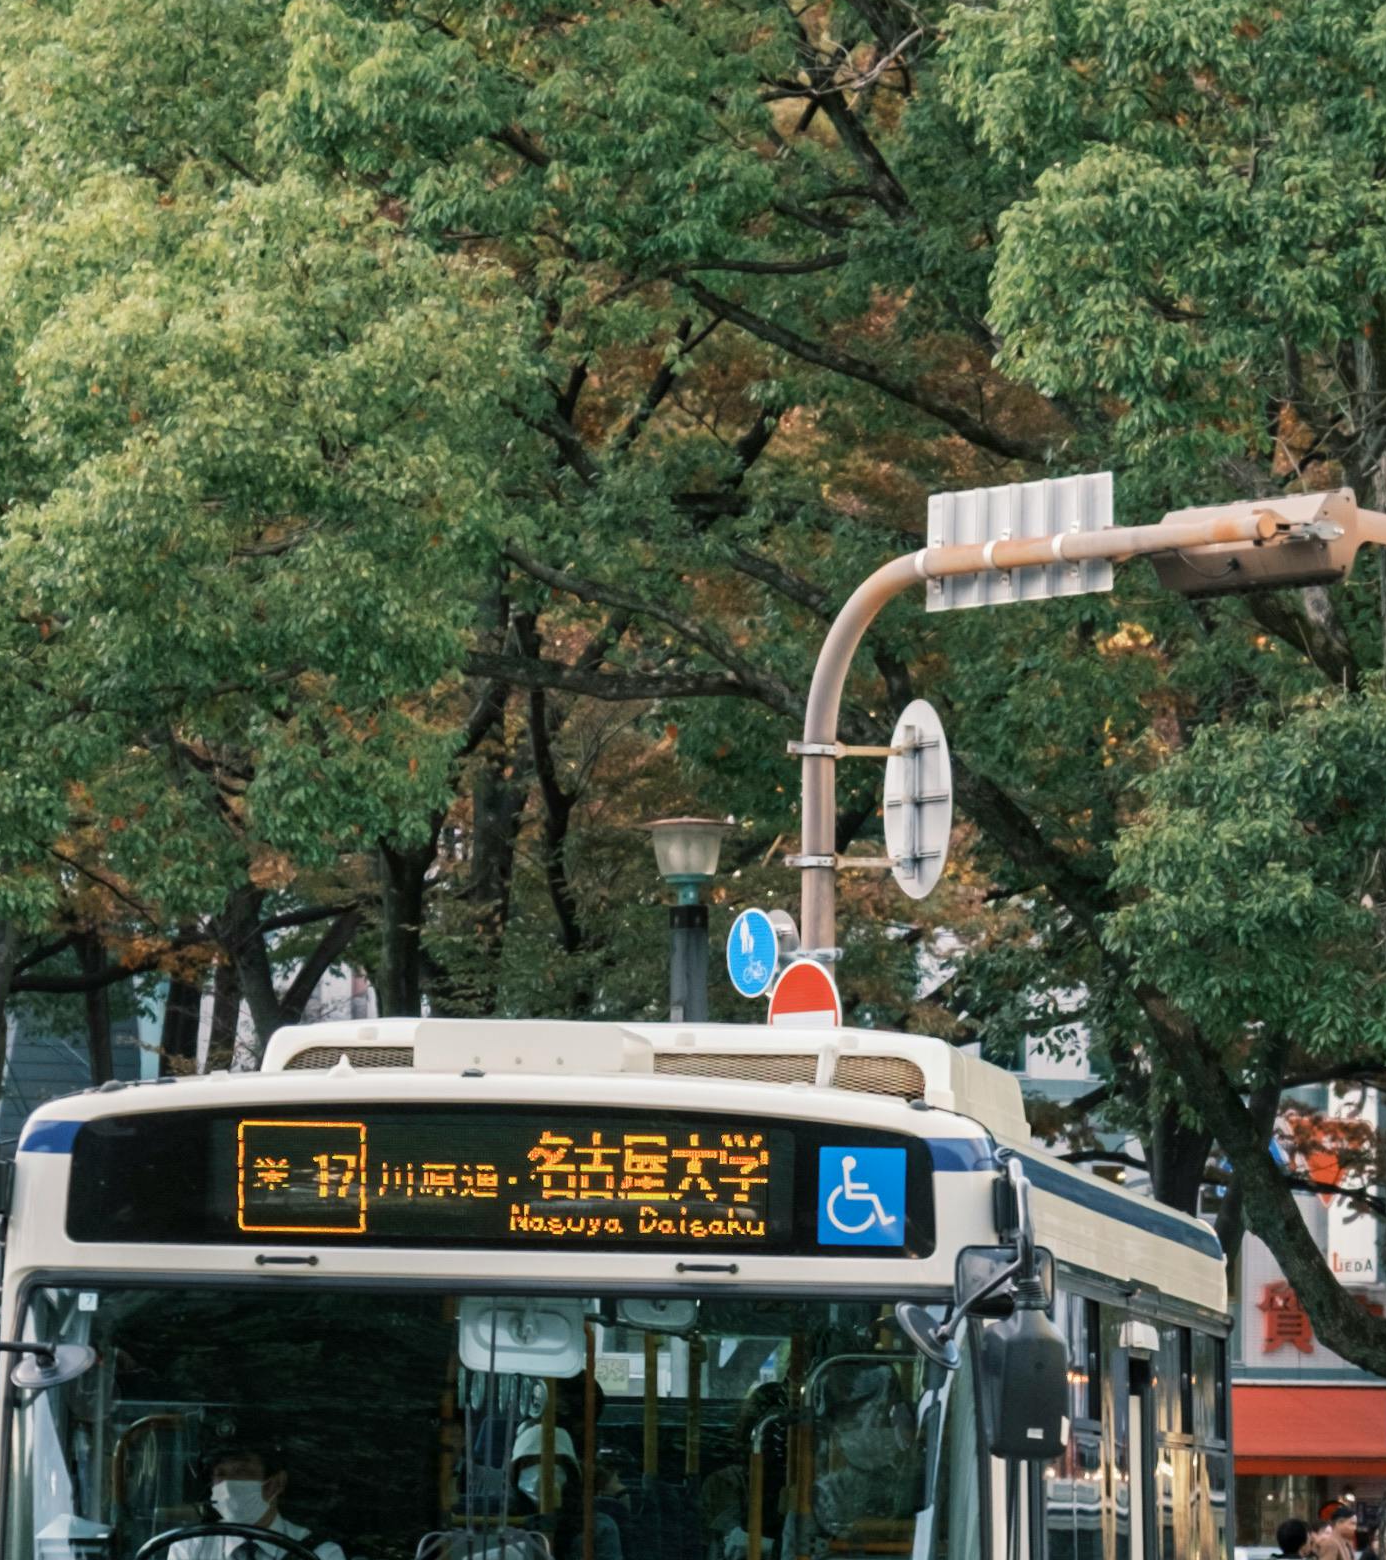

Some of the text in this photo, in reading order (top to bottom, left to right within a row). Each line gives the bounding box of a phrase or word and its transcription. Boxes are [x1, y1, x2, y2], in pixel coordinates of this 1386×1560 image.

[313, 1154, 358, 1198] 17
[527, 1130, 769, 1203] 名古屋大学
